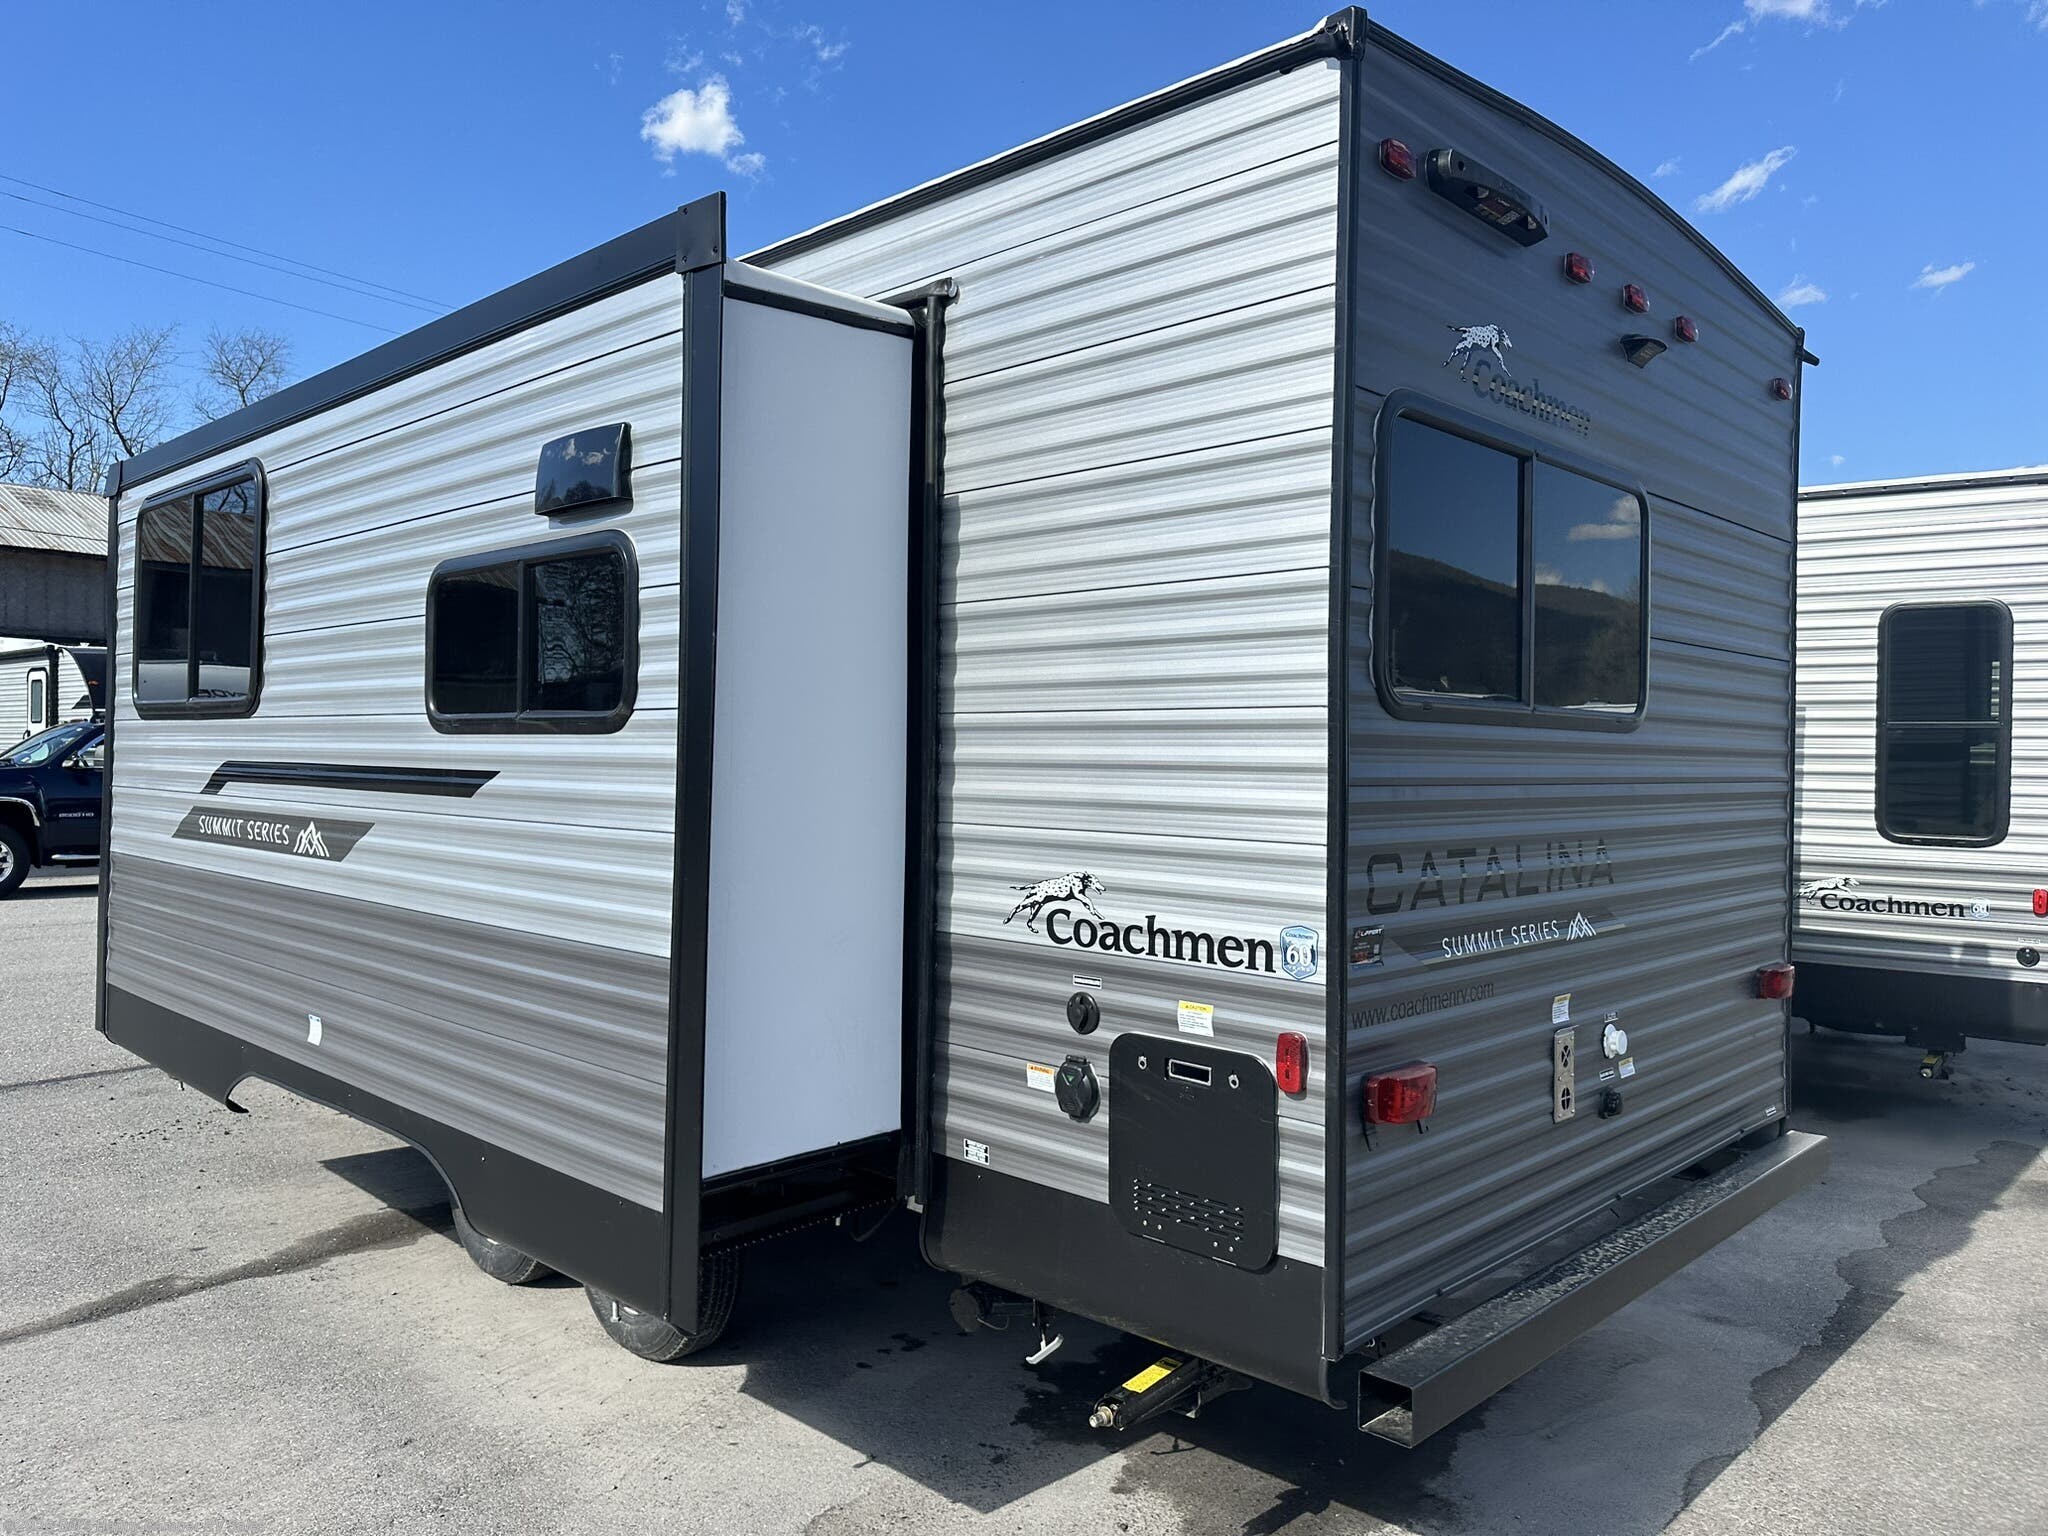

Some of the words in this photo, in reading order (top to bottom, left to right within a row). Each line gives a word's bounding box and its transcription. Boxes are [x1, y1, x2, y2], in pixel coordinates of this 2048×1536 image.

[1472, 359, 1590, 438] Coachmen
[199, 815, 244, 838] SUMMIT
[247, 820, 290, 845] SERIES
[1366, 838, 1615, 916] CATALINA
[1820, 893, 1966, 918] Coachmen
[1045, 908, 1276, 973] Coachmen
[1286, 943, 1312, 967] 60
[1442, 928, 1504, 958] SUMMIT
[1511, 919, 1560, 946] SERIES
[1352, 982, 1495, 1030] www.coachmenrv.com
